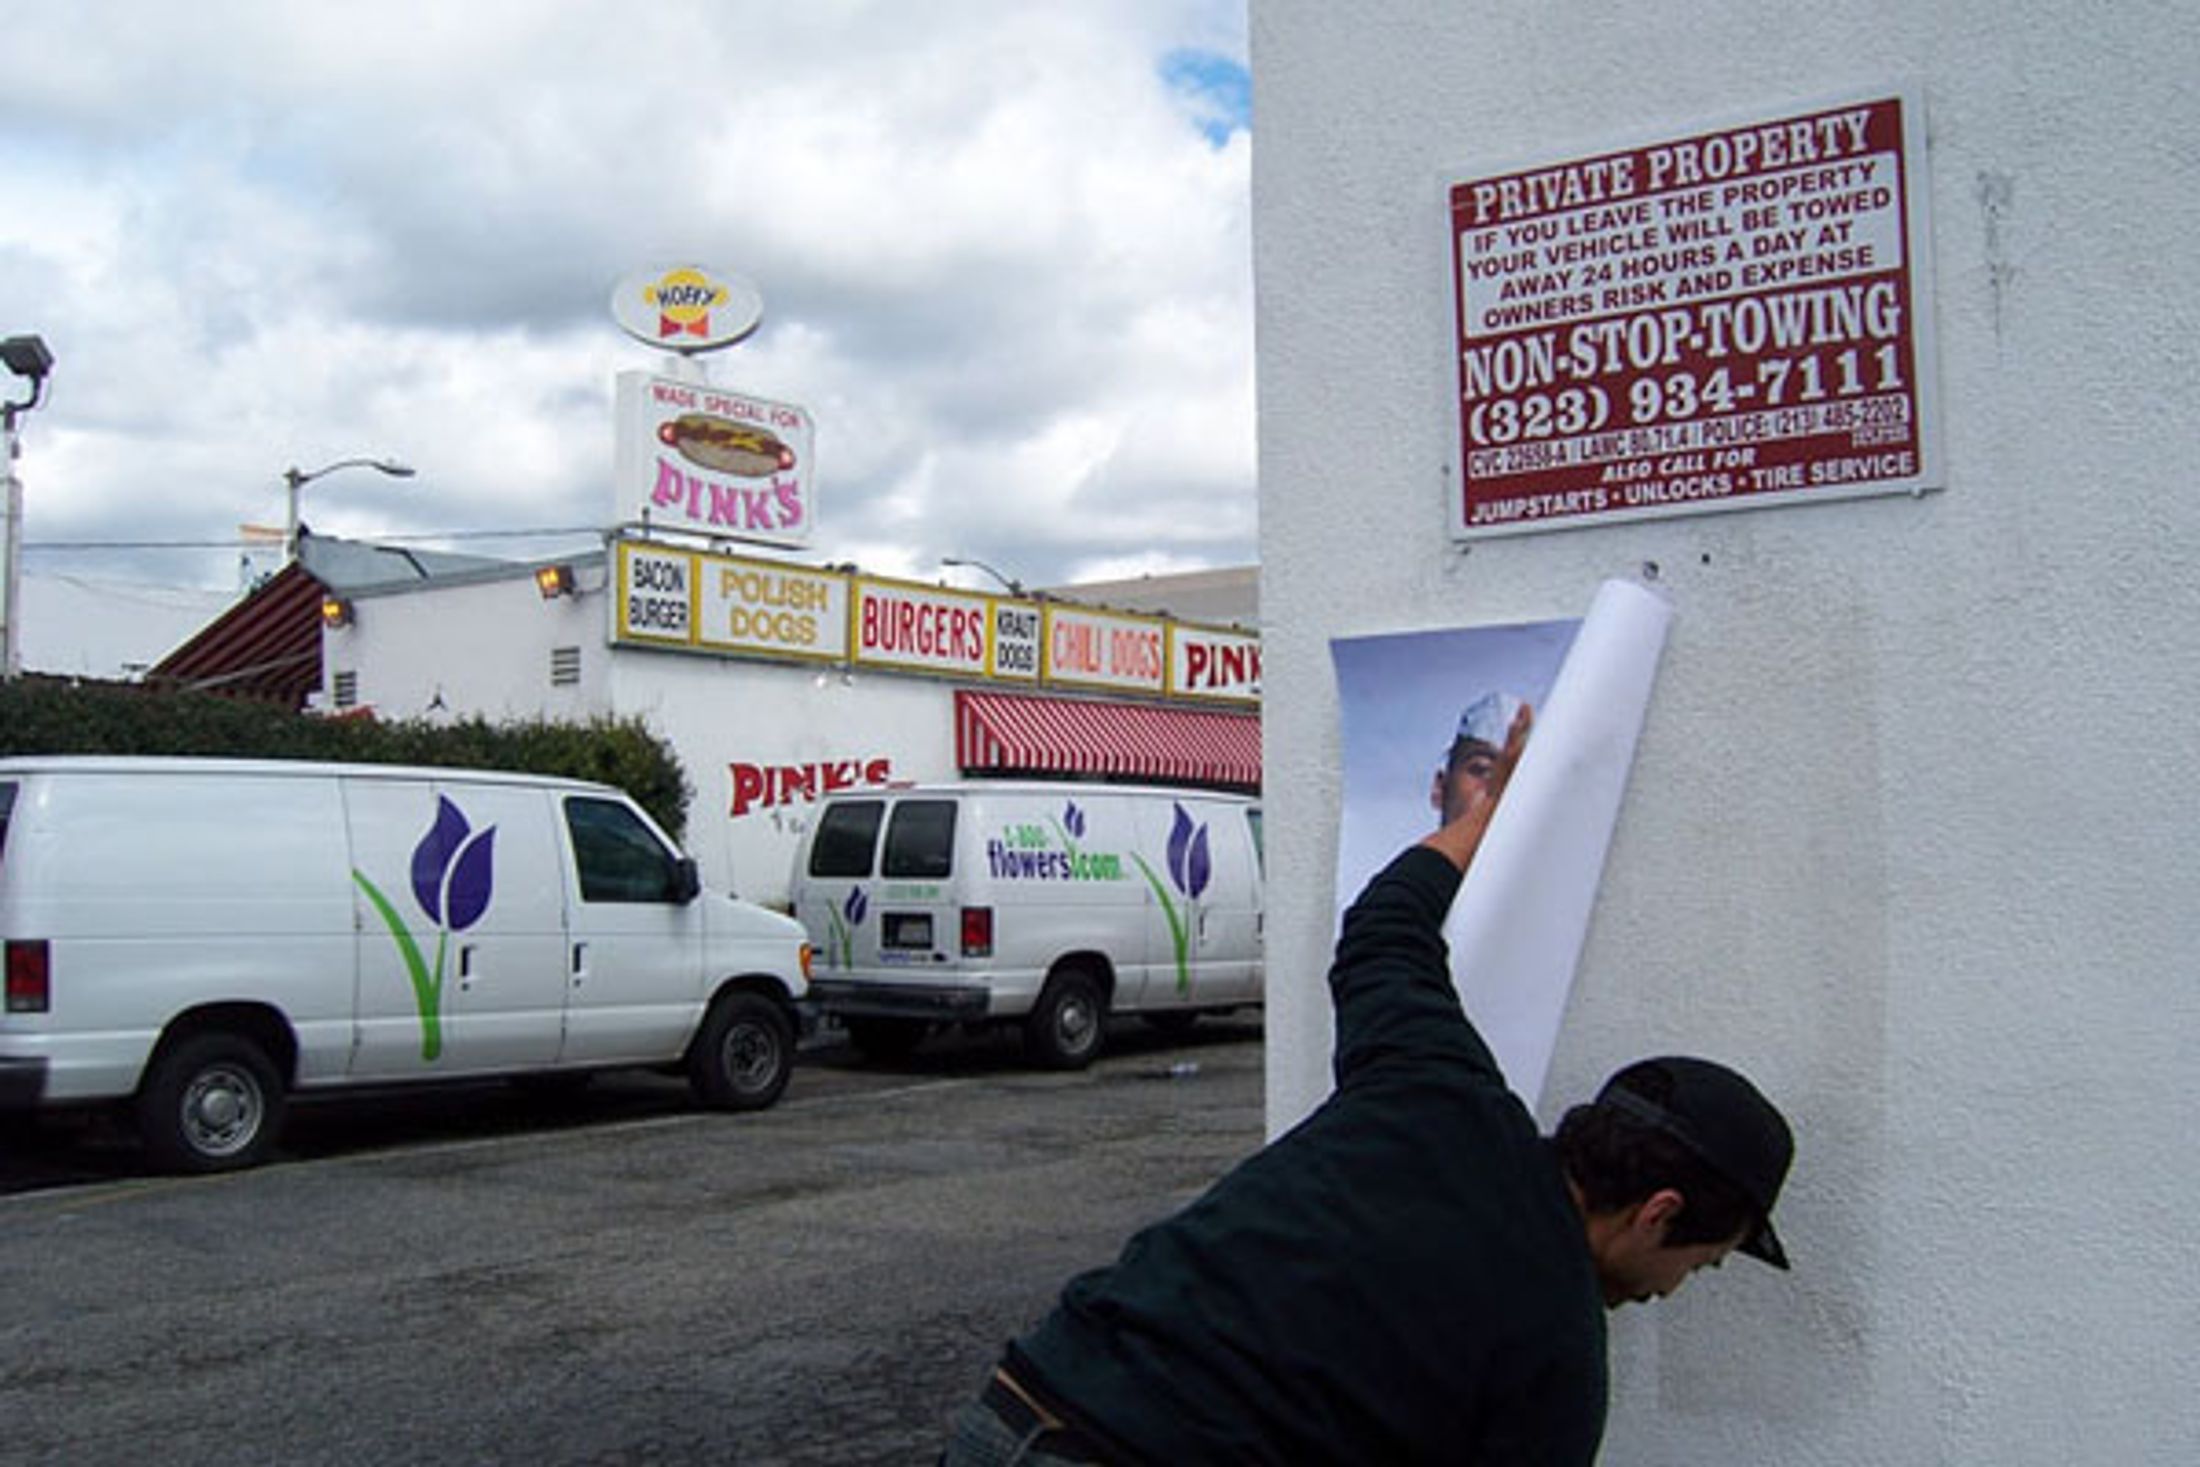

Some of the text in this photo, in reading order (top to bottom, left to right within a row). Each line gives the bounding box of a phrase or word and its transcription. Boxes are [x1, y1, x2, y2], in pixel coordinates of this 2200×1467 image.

[1473, 110, 1872, 223] PRIVATE PROPERTY
[1467, 186, 1891, 280] YOUR VEHICLE WILL BE TOWED
[1474, 161, 1877, 254] IF YOU LEAVE THE PROPERTY
[1484, 245, 1875, 330] OWNERS RISK AND EXPENSE
[1499, 221, 1853, 301] AWAY 24 HOURS A DAY AT
[656, 285, 716, 307] HOFFY
[652, 384, 800, 428] MADE SPECIAL FOR
[1469, 344, 1903, 445] (323) 934-7111
[650, 456, 804, 530] PINK'S
[1471, 450, 1914, 523] JUMPSTARTS UNLOCKS TIRE SERVICE
[1601, 446, 1756, 482] ALSO CALL FOR
[633, 558, 685, 592] BACON
[719, 568, 829, 613] POLISH
[628, 595, 688, 630] BURGER
[729, 606, 818, 646] DOGS
[862, 595, 983, 662] BURGERS
[997, 610, 1038, 639] KRAUT
[998, 642, 1034, 671] DOGS
[1053, 620, 1161, 681] CHILI DOGS
